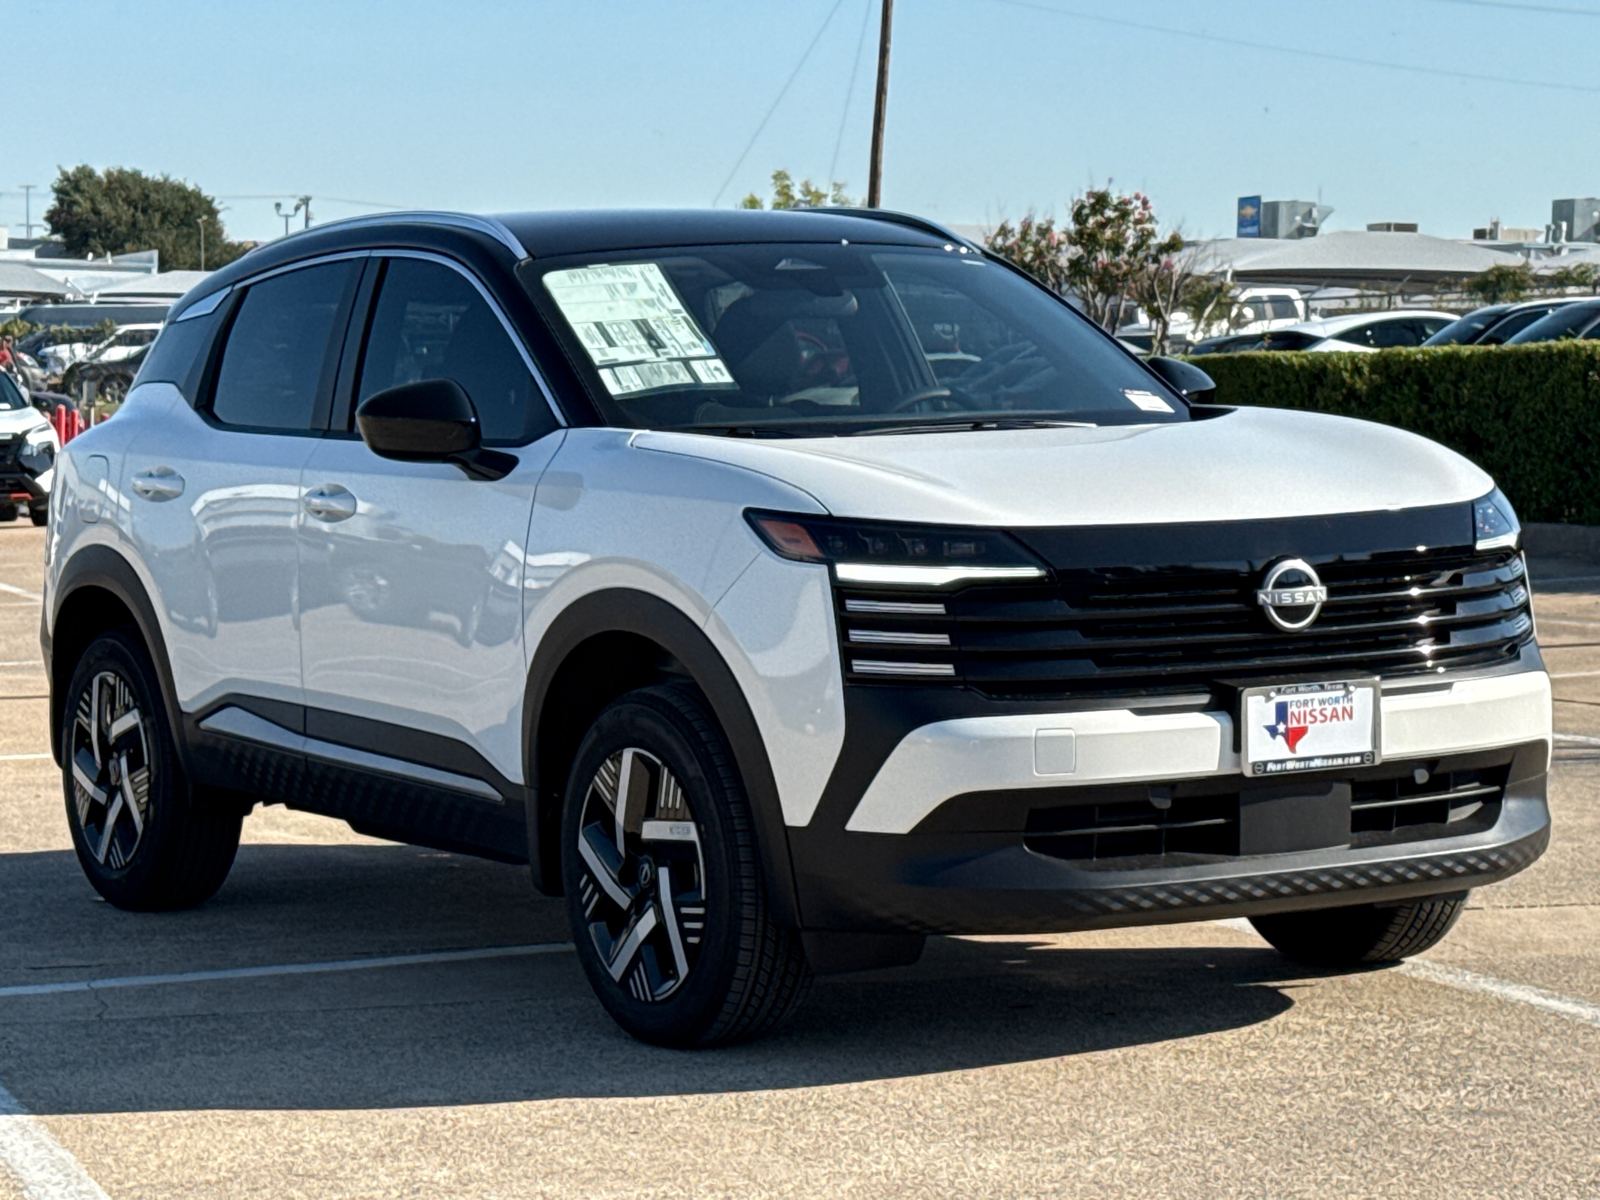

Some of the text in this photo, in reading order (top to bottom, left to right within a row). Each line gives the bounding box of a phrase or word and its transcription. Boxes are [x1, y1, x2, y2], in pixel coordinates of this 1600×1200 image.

[1259, 590, 1325, 604] NISSAN
[1290, 695, 1353, 708] FORT WORTH
[1290, 706, 1353, 725] NISSAN
